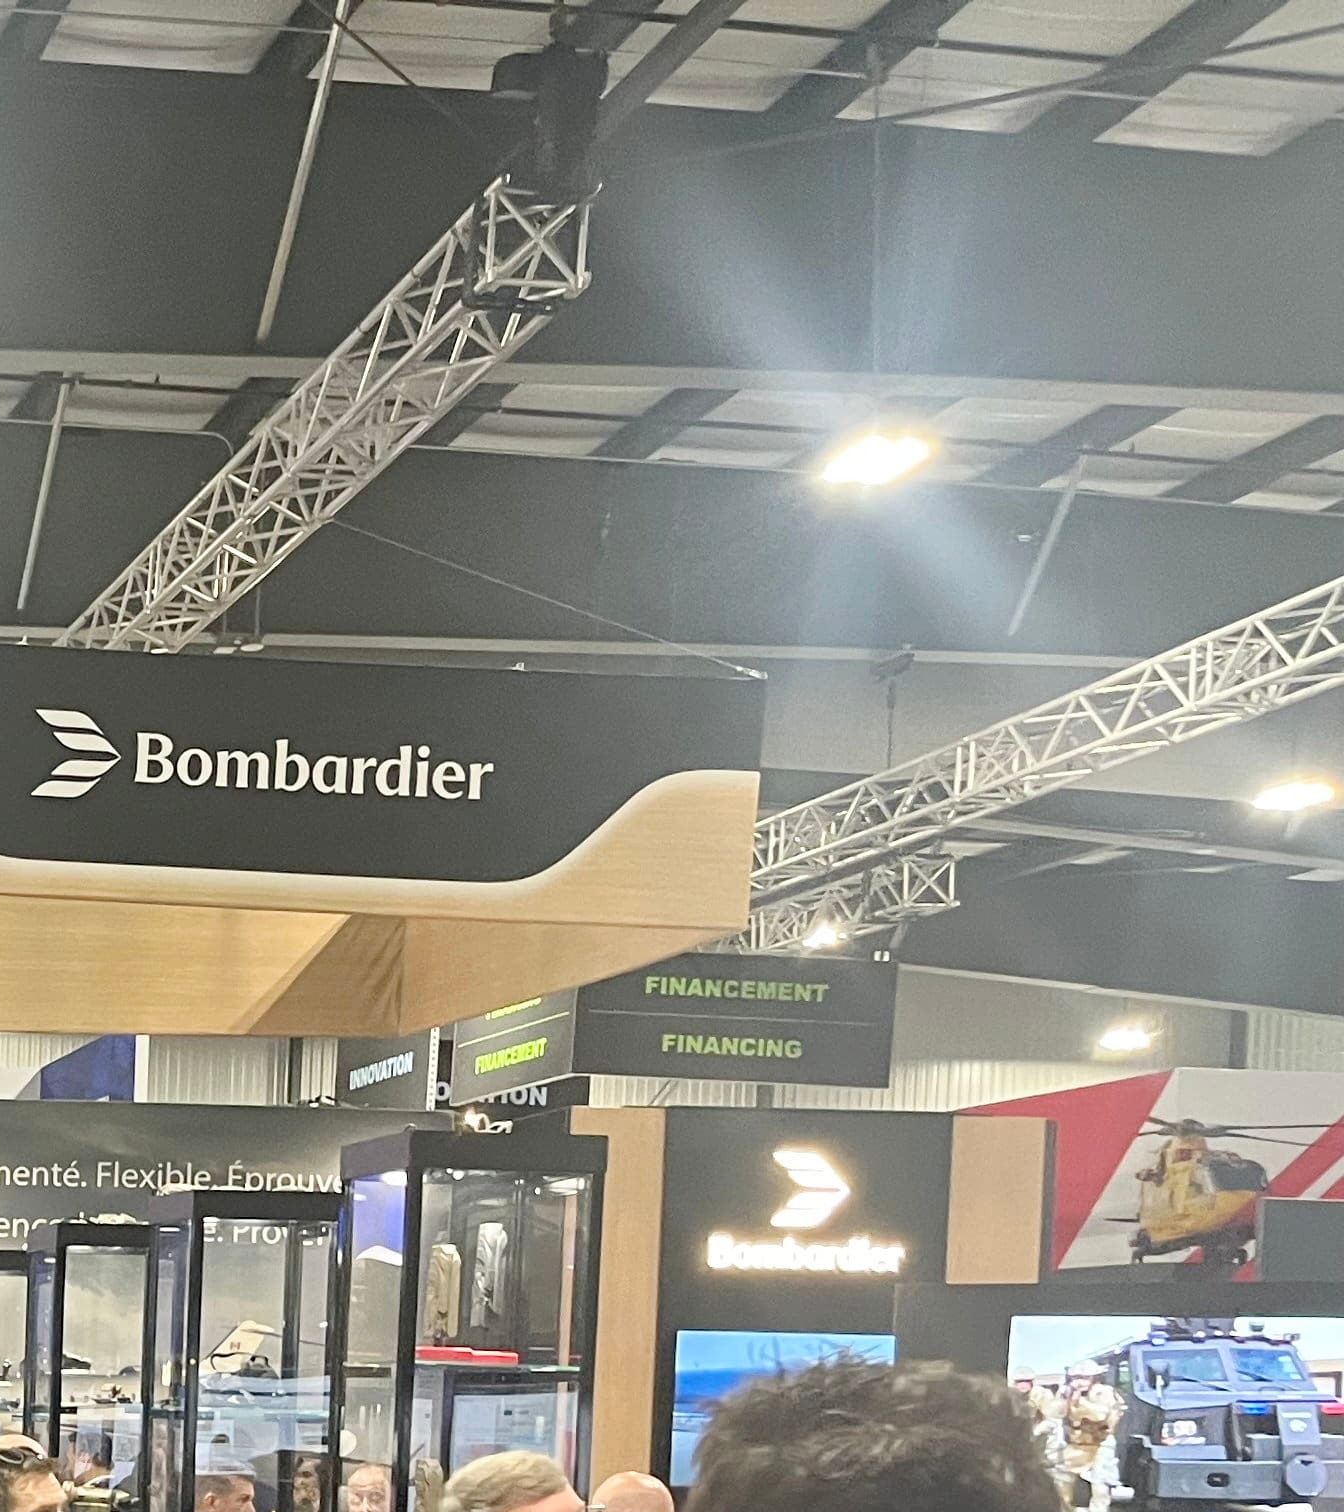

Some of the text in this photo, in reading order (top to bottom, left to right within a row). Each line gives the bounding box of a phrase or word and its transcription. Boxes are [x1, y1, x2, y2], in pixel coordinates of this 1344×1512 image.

[134, 731, 494, 800] Bombardier
[645, 976, 830, 1002] FINANCEMENT
[475, 1037, 548, 1076] FINANCEMENT
[662, 1034, 802, 1058] FINANCING
[349, 1051, 414, 1091] INNOVATION
